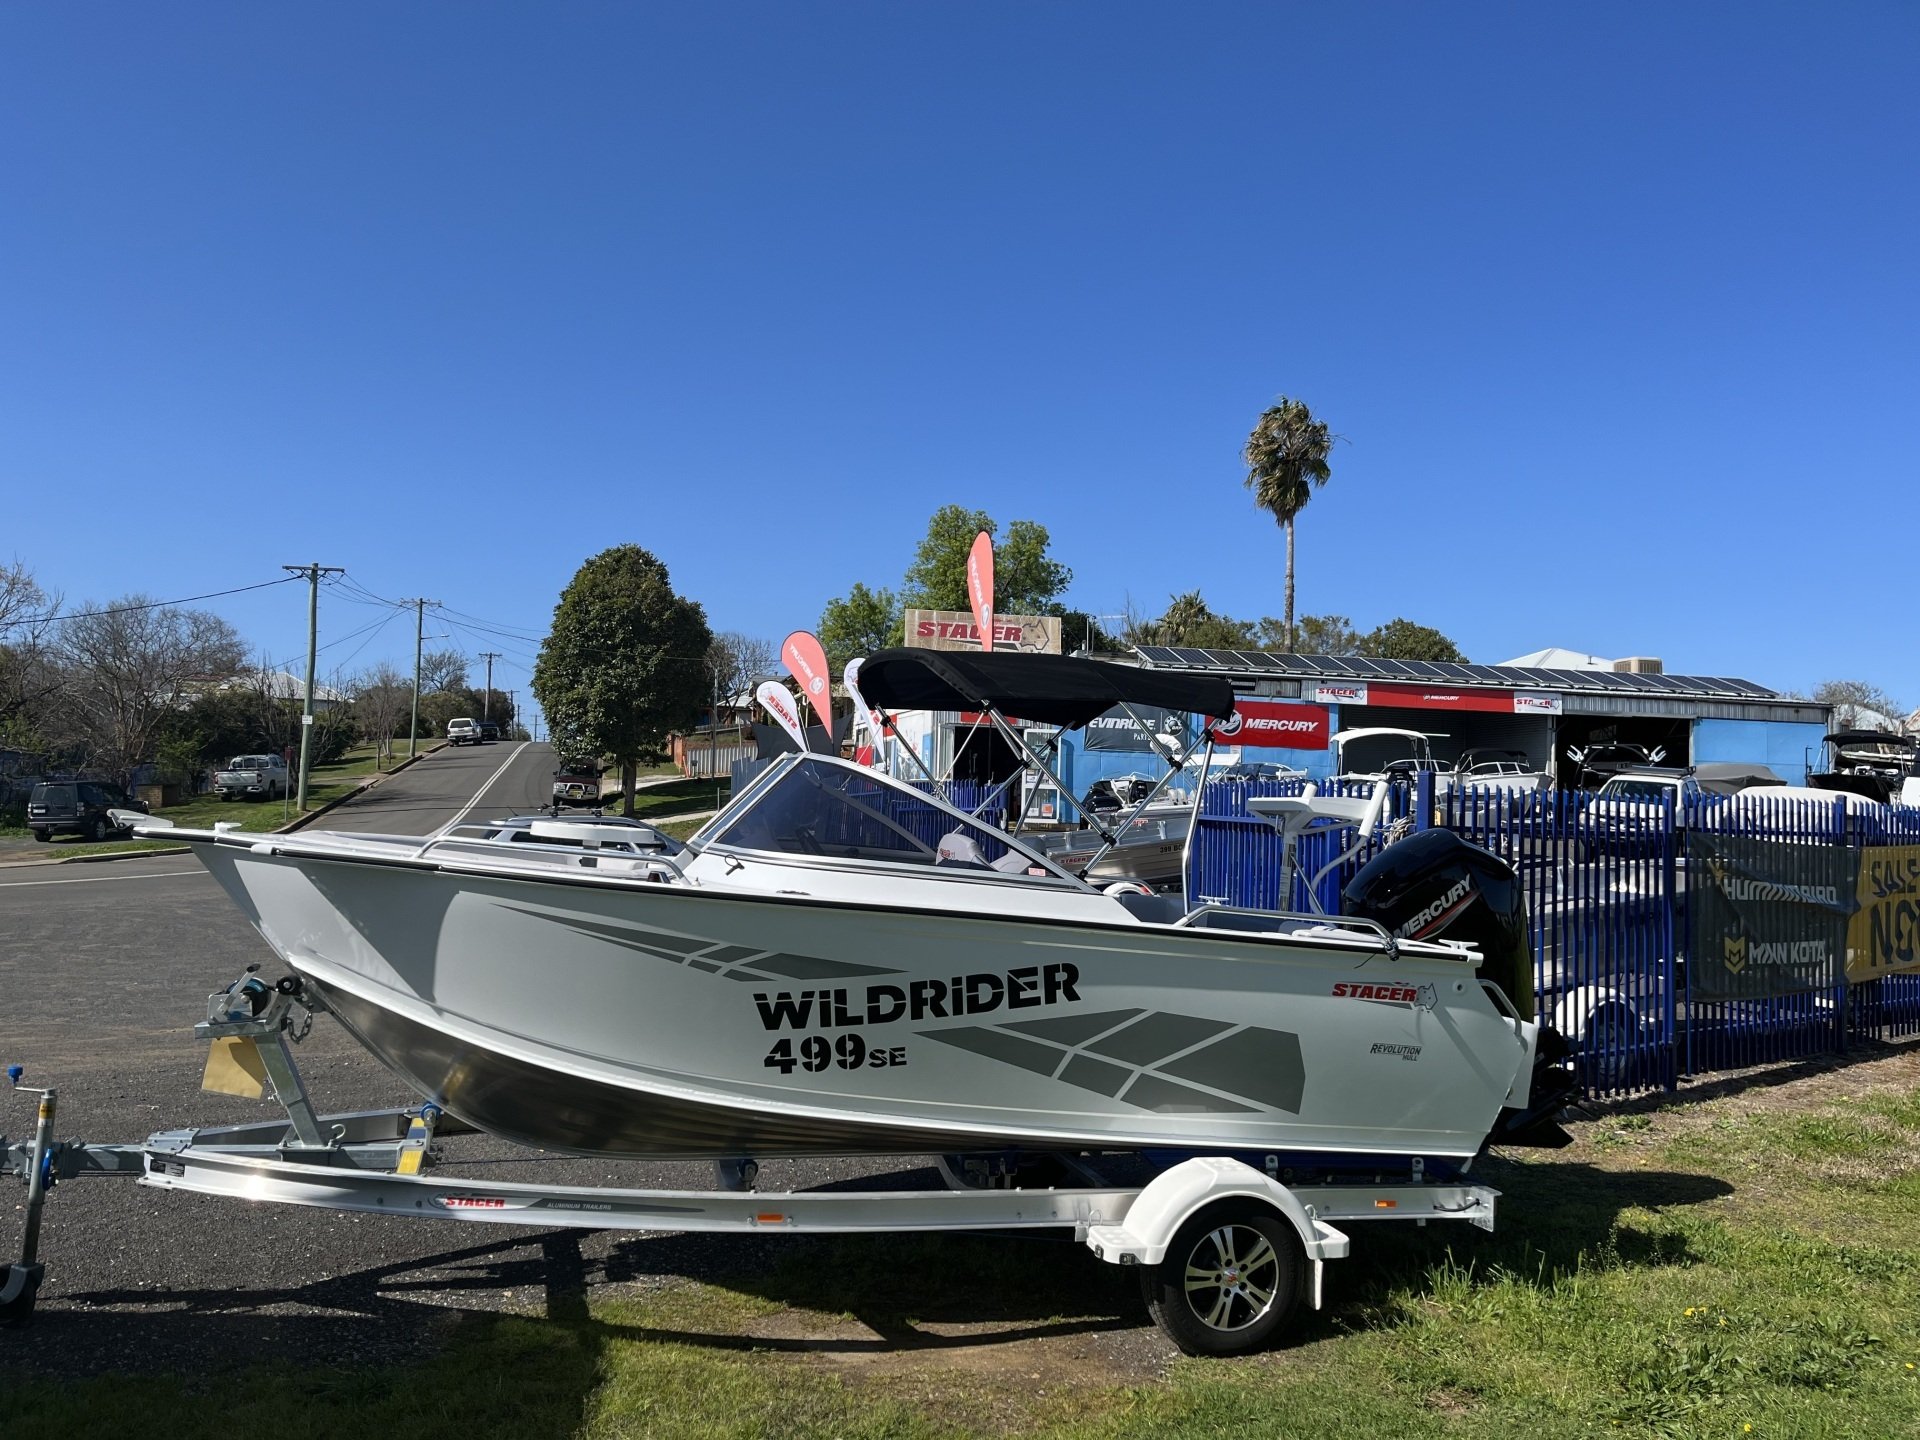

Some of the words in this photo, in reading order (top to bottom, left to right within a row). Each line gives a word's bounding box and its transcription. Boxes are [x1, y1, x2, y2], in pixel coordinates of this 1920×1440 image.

[1317, 687, 1356, 696] STACER
[1244, 717, 1319, 732] MERCURY
[1393, 873, 1471, 938] MERCURY
[1790, 939, 1827, 963] KOTA
[752, 962, 1082, 1031] WILDRIDER
[1331, 983, 1418, 1003] STACER
[1369, 1043, 1422, 1056] REVOLUTION
[445, 1196, 506, 1208] STACER
